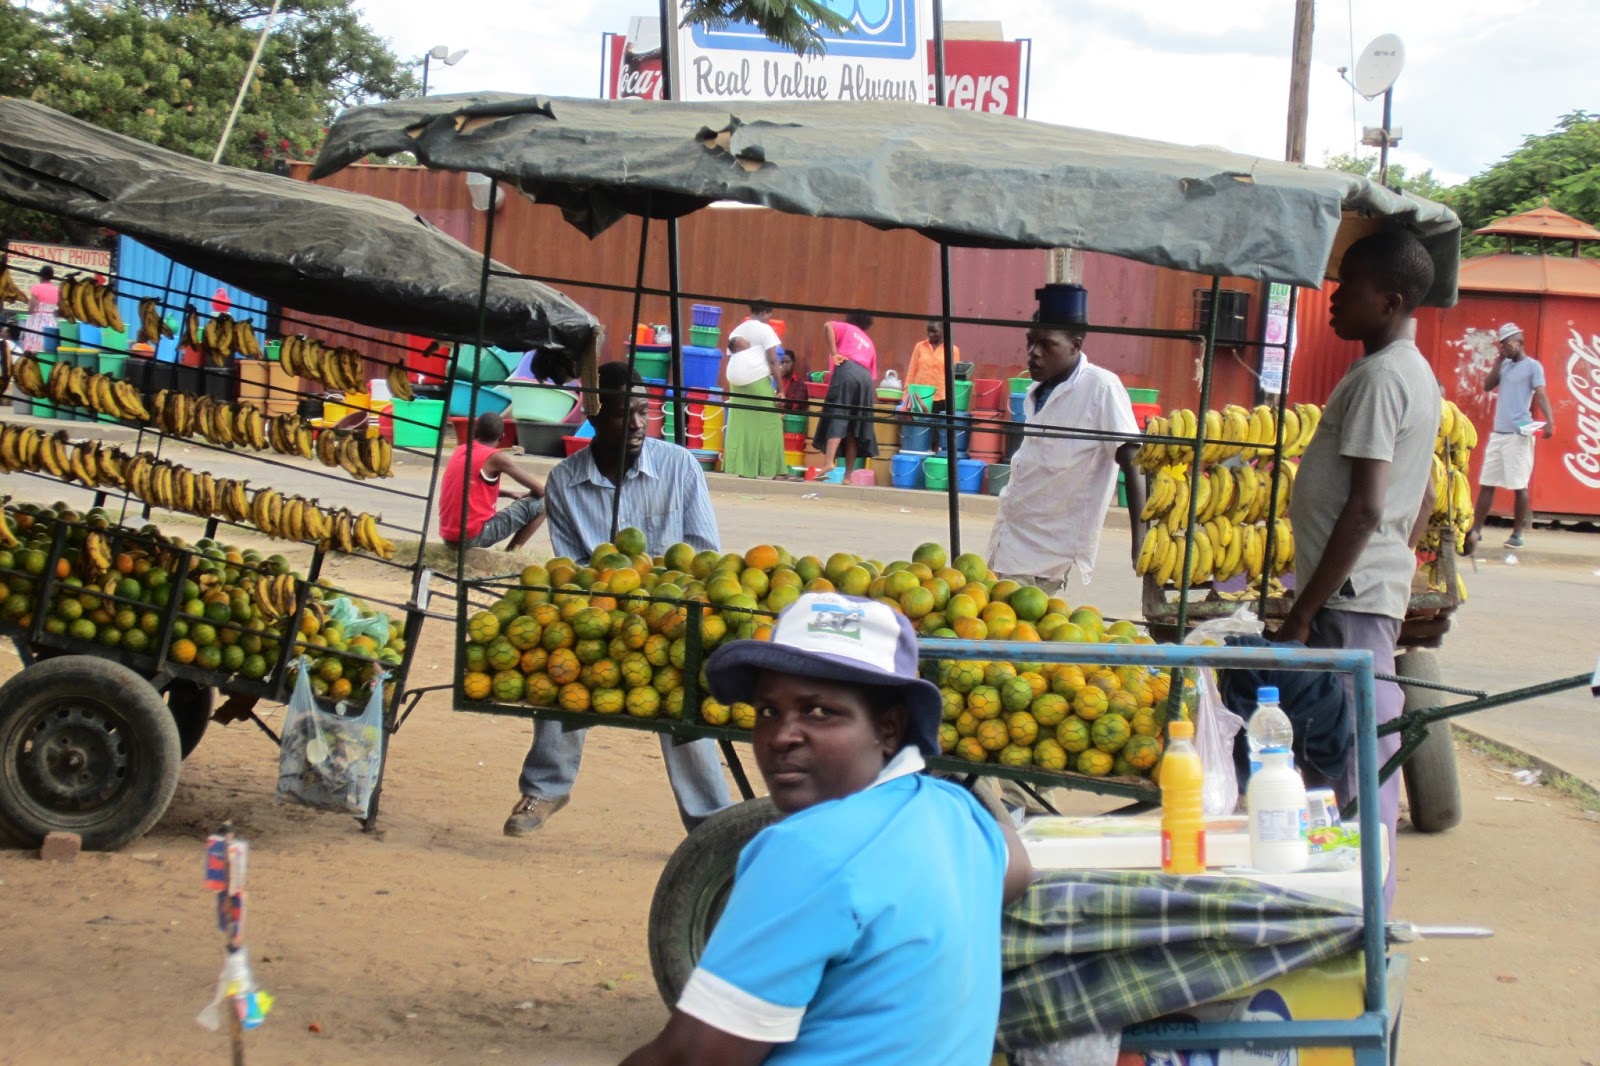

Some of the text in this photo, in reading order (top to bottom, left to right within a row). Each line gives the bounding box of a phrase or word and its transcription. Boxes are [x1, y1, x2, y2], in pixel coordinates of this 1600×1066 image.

[693, 56, 917, 102] Real Value Always
[68, 250, 109, 267] PHOTOS
